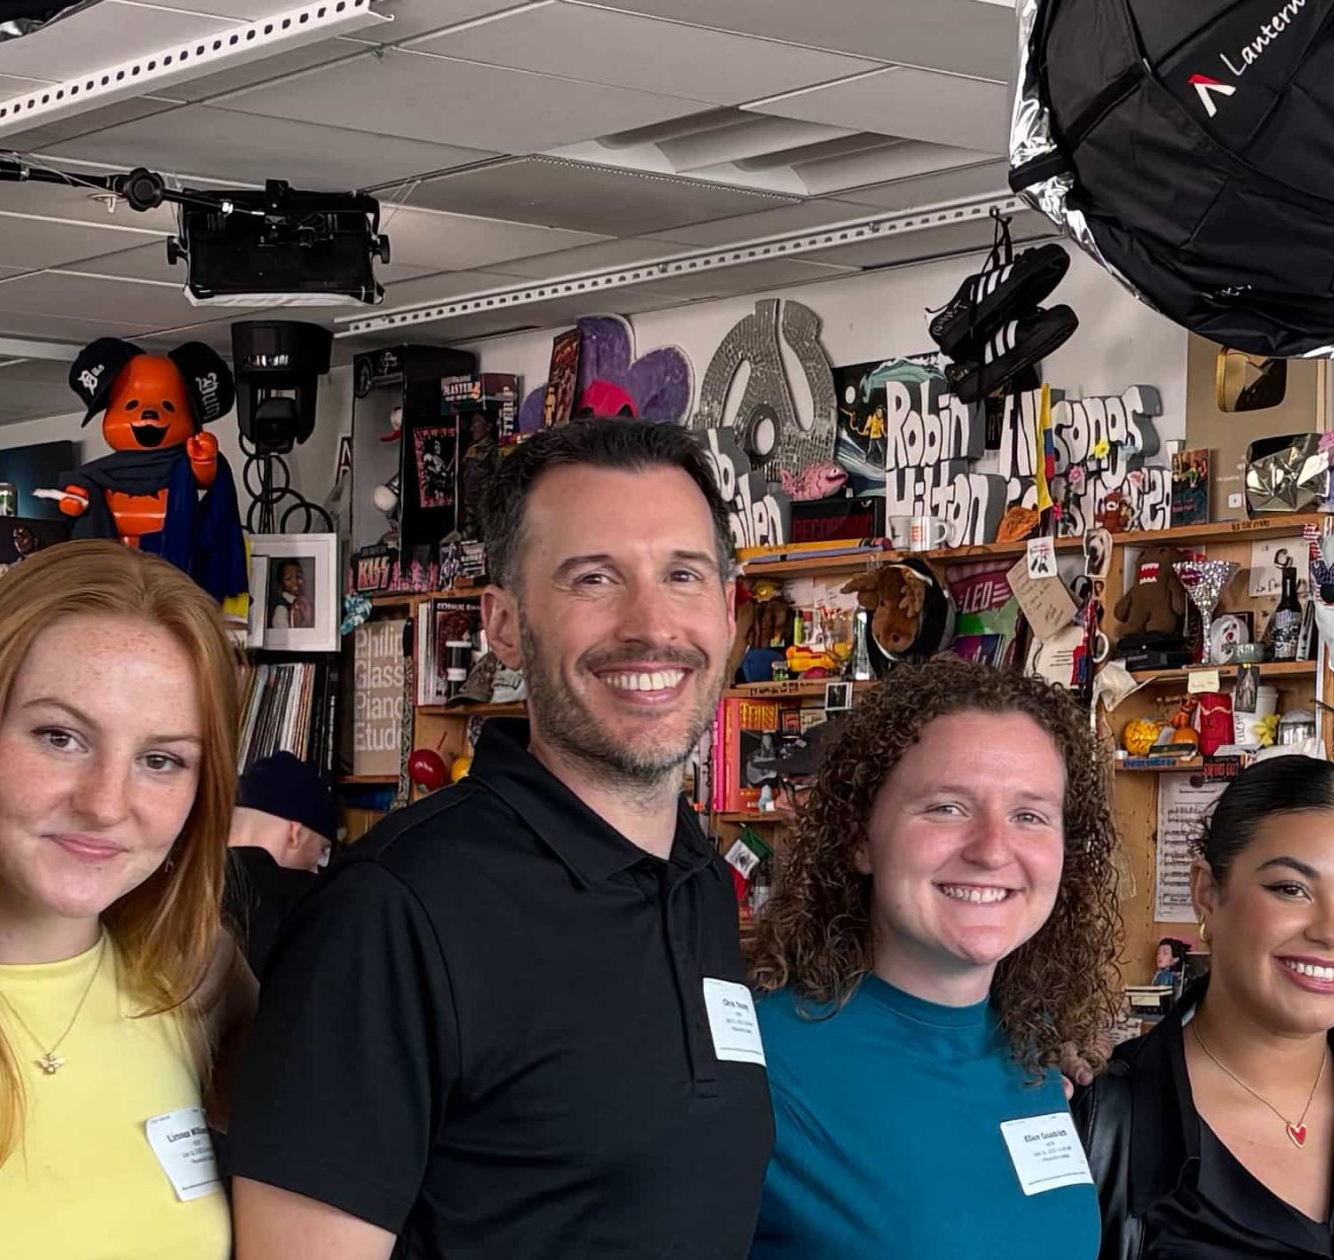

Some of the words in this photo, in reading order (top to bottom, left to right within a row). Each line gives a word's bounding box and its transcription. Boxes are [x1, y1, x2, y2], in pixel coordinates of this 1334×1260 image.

[1220, 0, 1306, 76] Lantern
[886, 379, 970, 471] Robin
[358, 556, 390, 591] KISS
[355, 625, 403, 662] Philip
[355, 659, 404, 689] Glass
